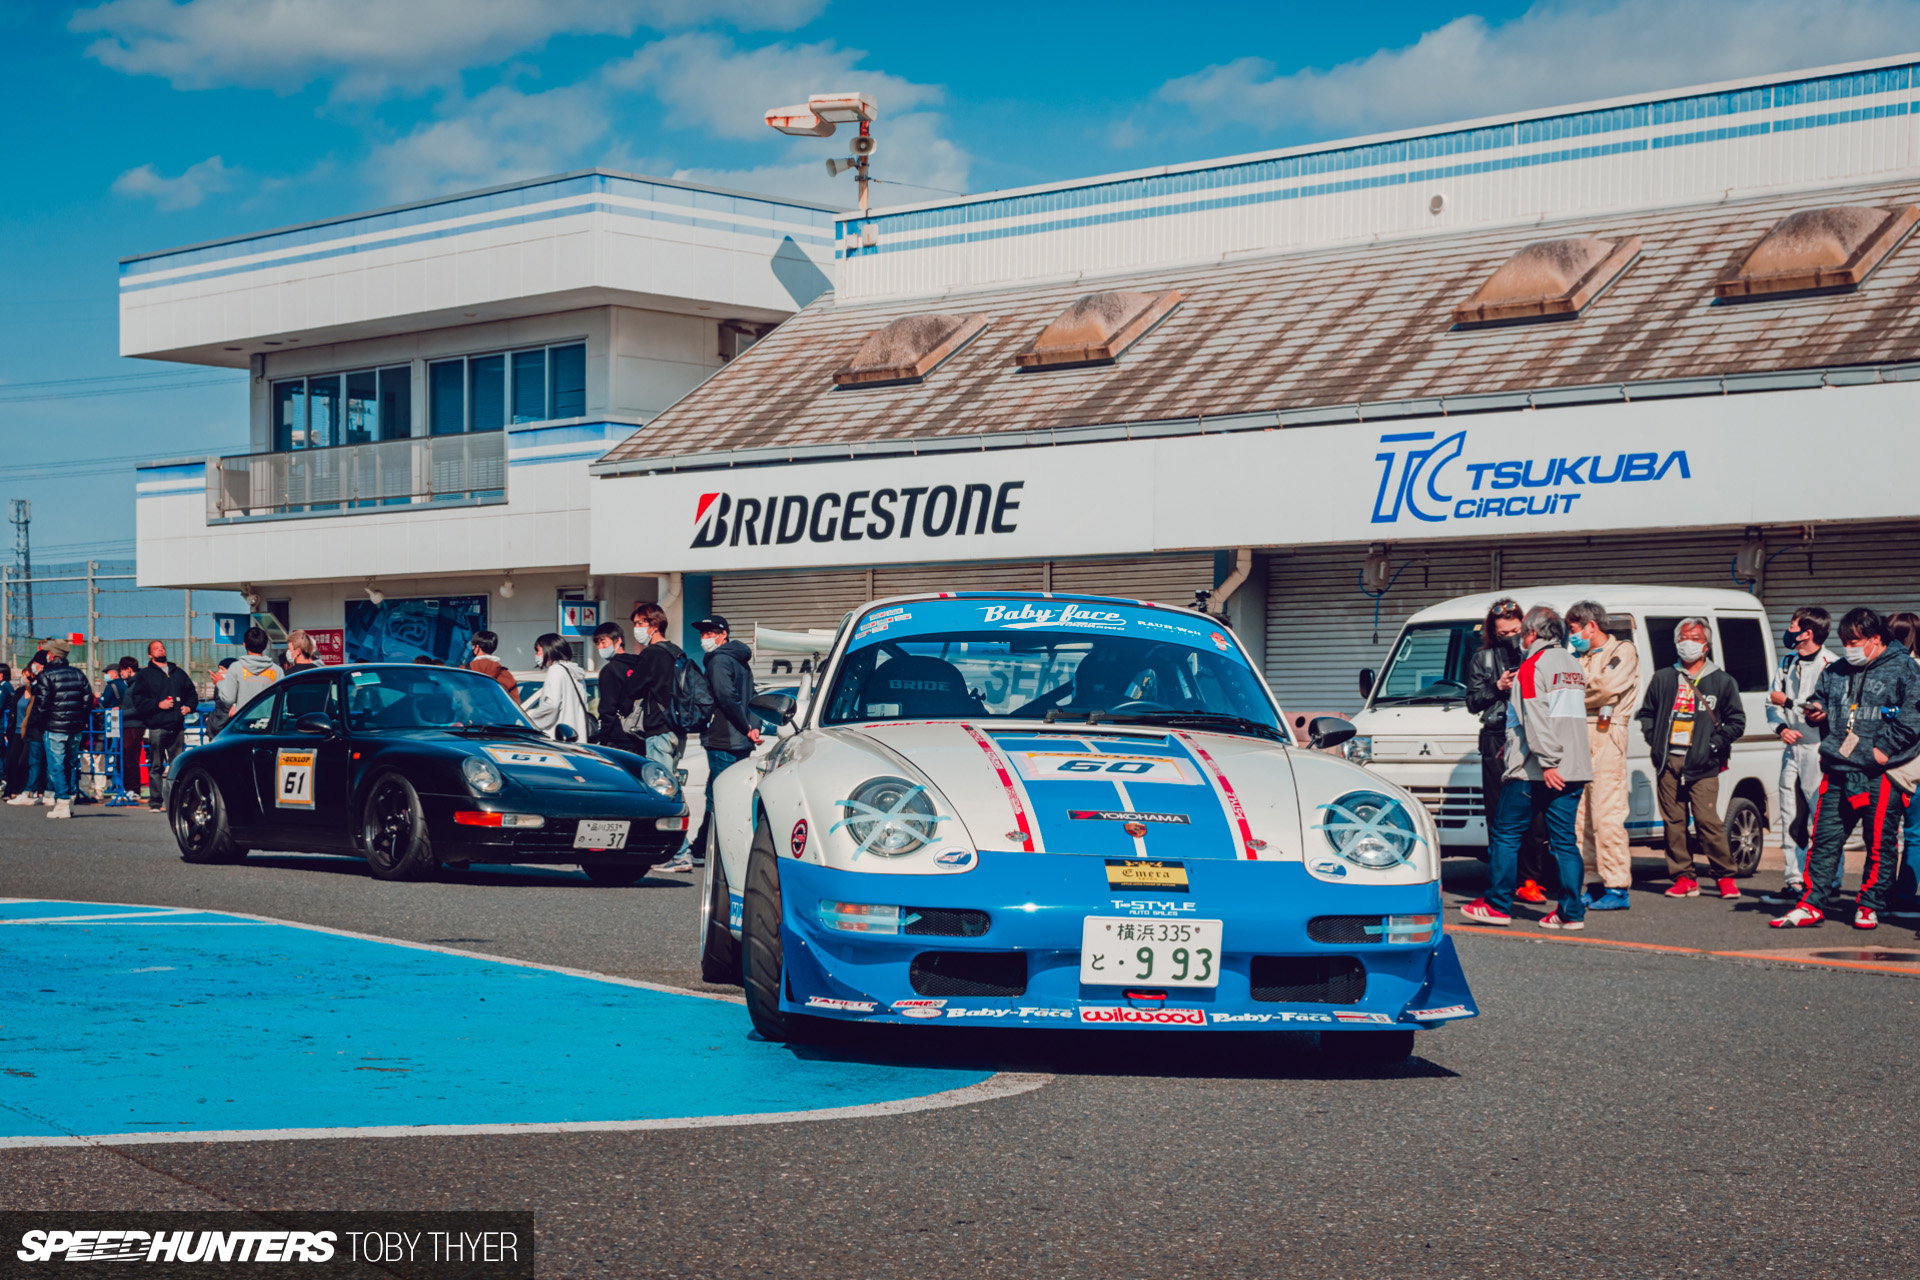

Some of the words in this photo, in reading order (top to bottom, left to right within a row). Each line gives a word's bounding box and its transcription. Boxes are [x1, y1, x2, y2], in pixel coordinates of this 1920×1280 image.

[1466, 451, 1691, 490] TSUKUBA
[690, 480, 1025, 549] BRIDGESTONE
[889, 679, 951, 692] BRIDE
[511, 754, 547, 762] 61
[1057, 760, 1155, 774] 60
[284, 771, 305, 794] 61
[1099, 811, 1184, 823] YOKOHAMA
[1122, 868, 1171, 878] Emera
[1117, 923, 1155, 942] 横浜
[1157, 924, 1191, 942] 335
[1091, 953, 1105, 971] と
[946, 1003, 1073, 1018] Baby-Face
[1082, 1007, 1204, 1024] wilwood
[1209, 1012, 1332, 1023] Baby-Face
